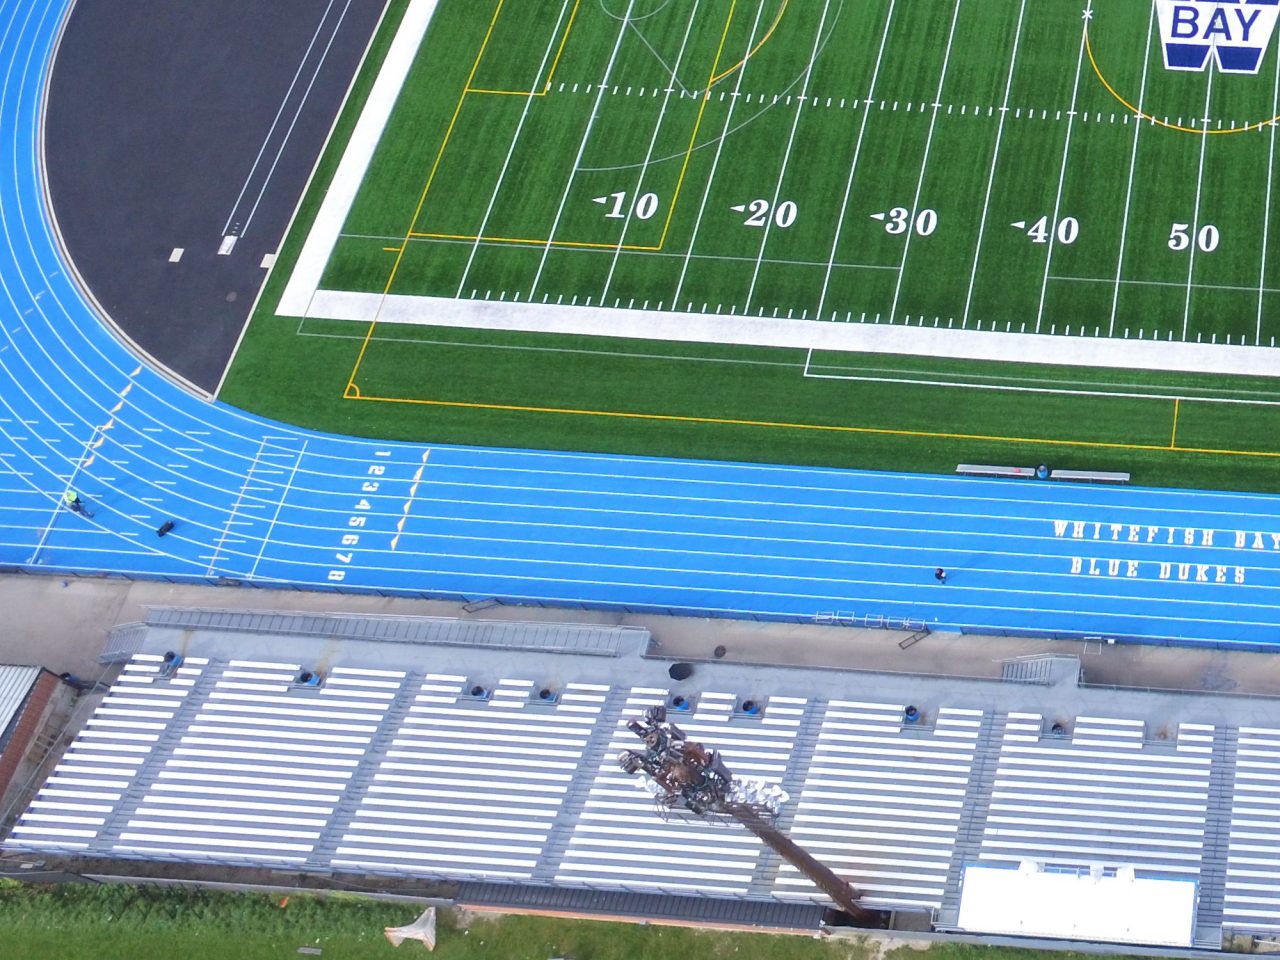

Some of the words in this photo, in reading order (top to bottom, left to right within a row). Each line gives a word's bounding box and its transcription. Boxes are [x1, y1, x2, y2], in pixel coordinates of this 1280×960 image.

[1170, 5, 1261, 42] BAY
[603, 191, 659, 220] 10
[743, 199, 798, 228] 20
[884, 207, 939, 236] 30
[1025, 215, 1080, 245] 40
[1167, 223, 1220, 252] 50
[368, 465, 385, 475] 2
[361, 481, 380, 492] 3
[354, 498, 371, 510] 4
[348, 516, 367, 527] 5
[1053, 519, 1214, 546] WHITEFISH
[341, 534, 360, 545] 6
[335, 552, 353, 563] 7
[1070, 556, 1139, 577] BLUE
[1159, 562, 1246, 584] DUKES
[327, 570, 346, 581] 8
